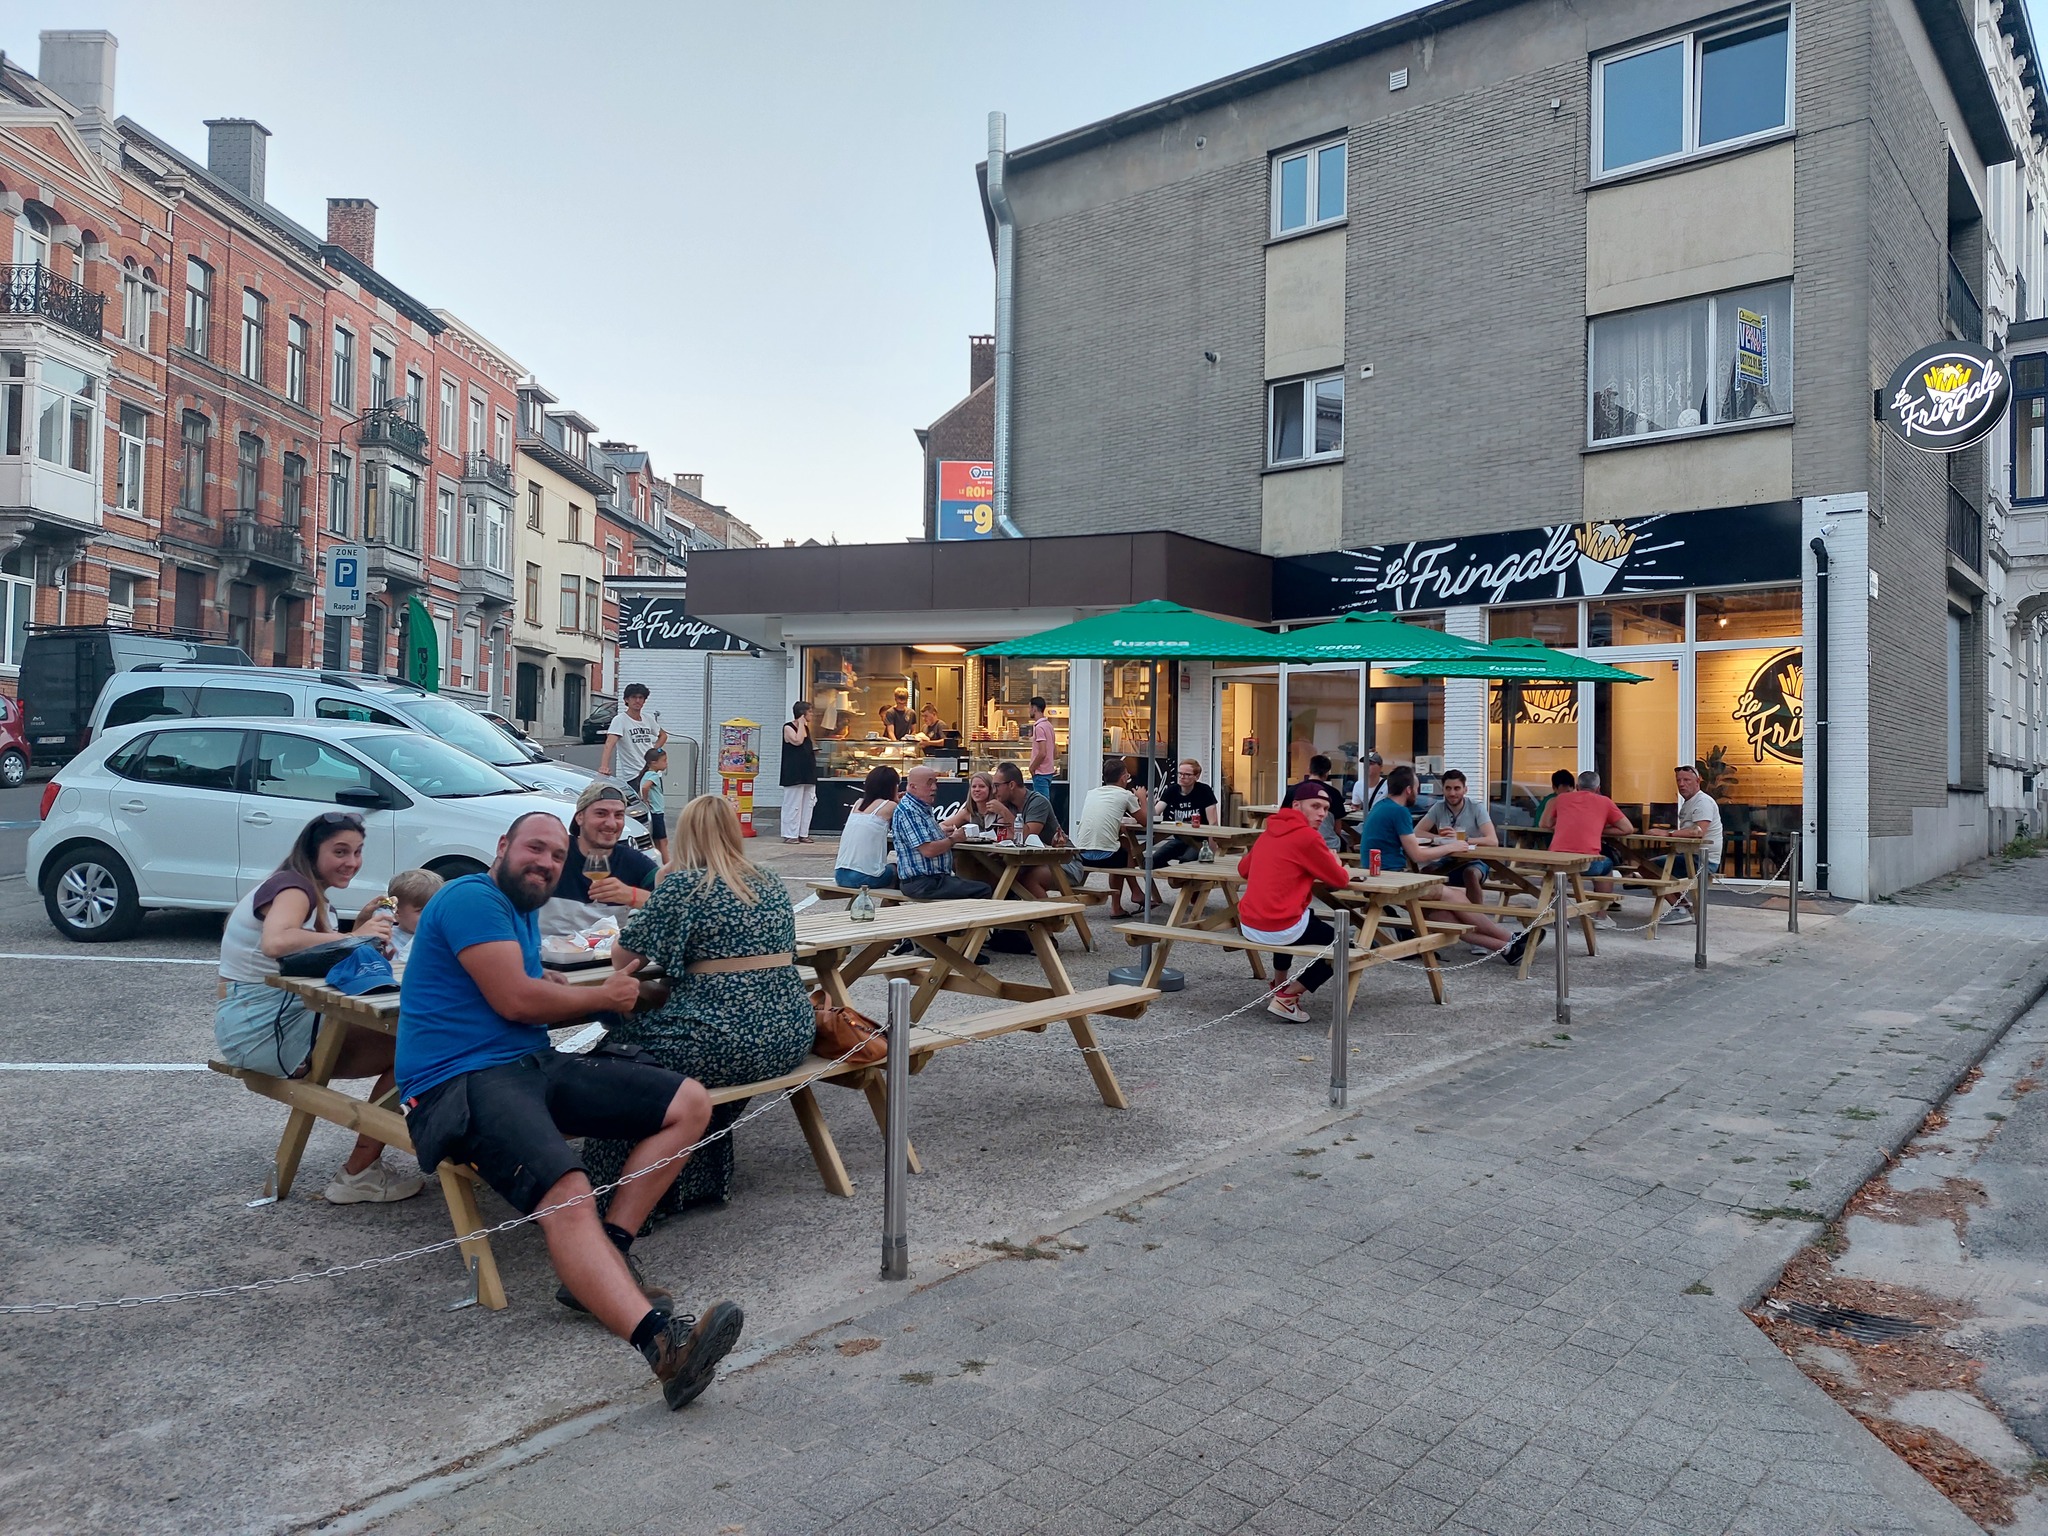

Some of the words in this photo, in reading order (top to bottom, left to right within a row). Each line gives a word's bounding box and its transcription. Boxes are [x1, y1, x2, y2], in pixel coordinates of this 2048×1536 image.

[1890, 388, 1912, 409] La
[1900, 359, 2003, 437] Fringale
[966, 486, 985, 498] ROI
[338, 562, 353, 583] P
[1376, 557, 1409, 591] La
[1409, 524, 1579, 609] Fringale
[333, 603, 356, 611] Rappel
[626, 613, 646, 631] La
[1733, 691, 1763, 718] La
[1747, 703, 1803, 761] Fri
